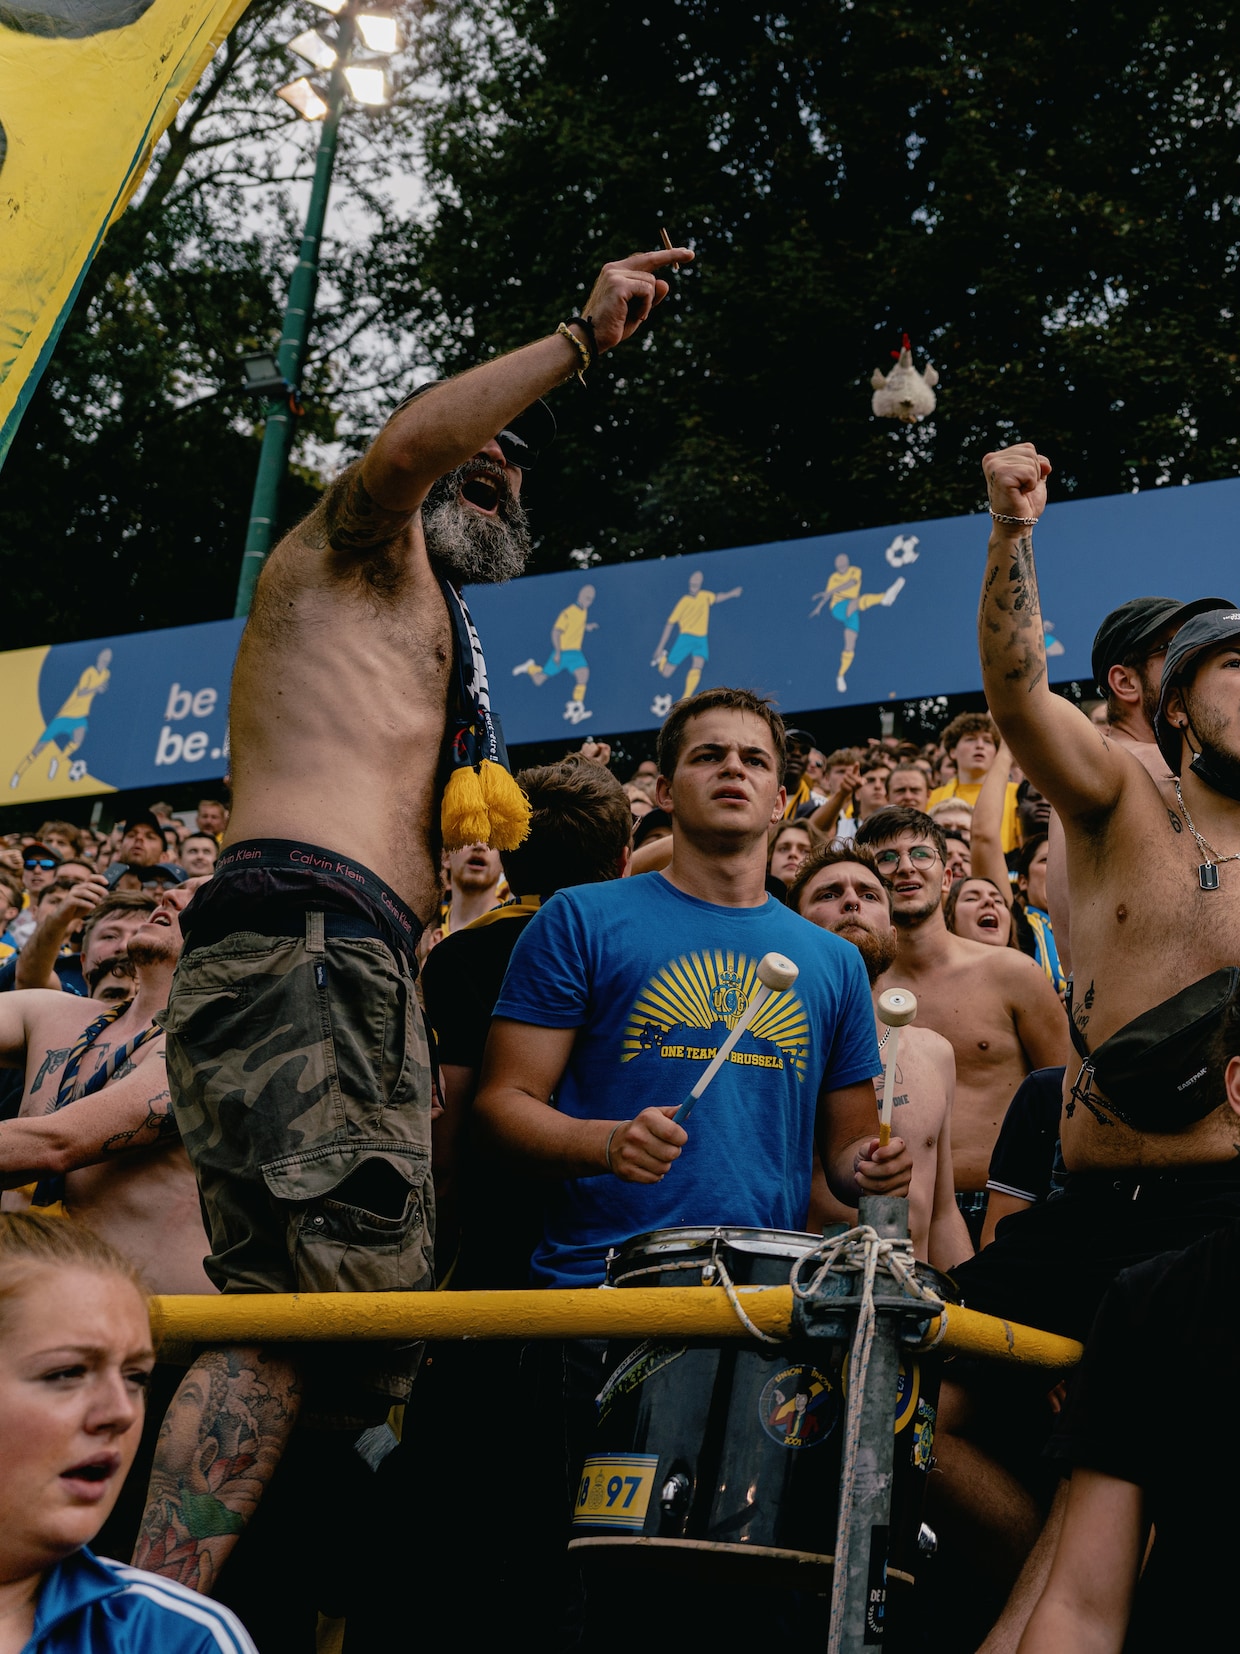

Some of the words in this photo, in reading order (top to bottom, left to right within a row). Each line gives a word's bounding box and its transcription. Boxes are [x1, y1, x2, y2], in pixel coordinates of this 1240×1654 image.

[164, 682, 218, 721] be
[236, 848, 262, 861] Klein
[289, 850, 333, 871] Calvin
[335, 862, 366, 885] Klein
[380, 891, 400, 919] Calvin
[399, 912, 413, 935] Klein
[660, 1045, 685, 1059] ONE
[686, 1047, 718, 1061] TEAM
[730, 1052, 784, 1070] BRUSSELS
[1177, 1066, 1207, 1091] EASTPAK
[605, 1475, 644, 1509] 97
